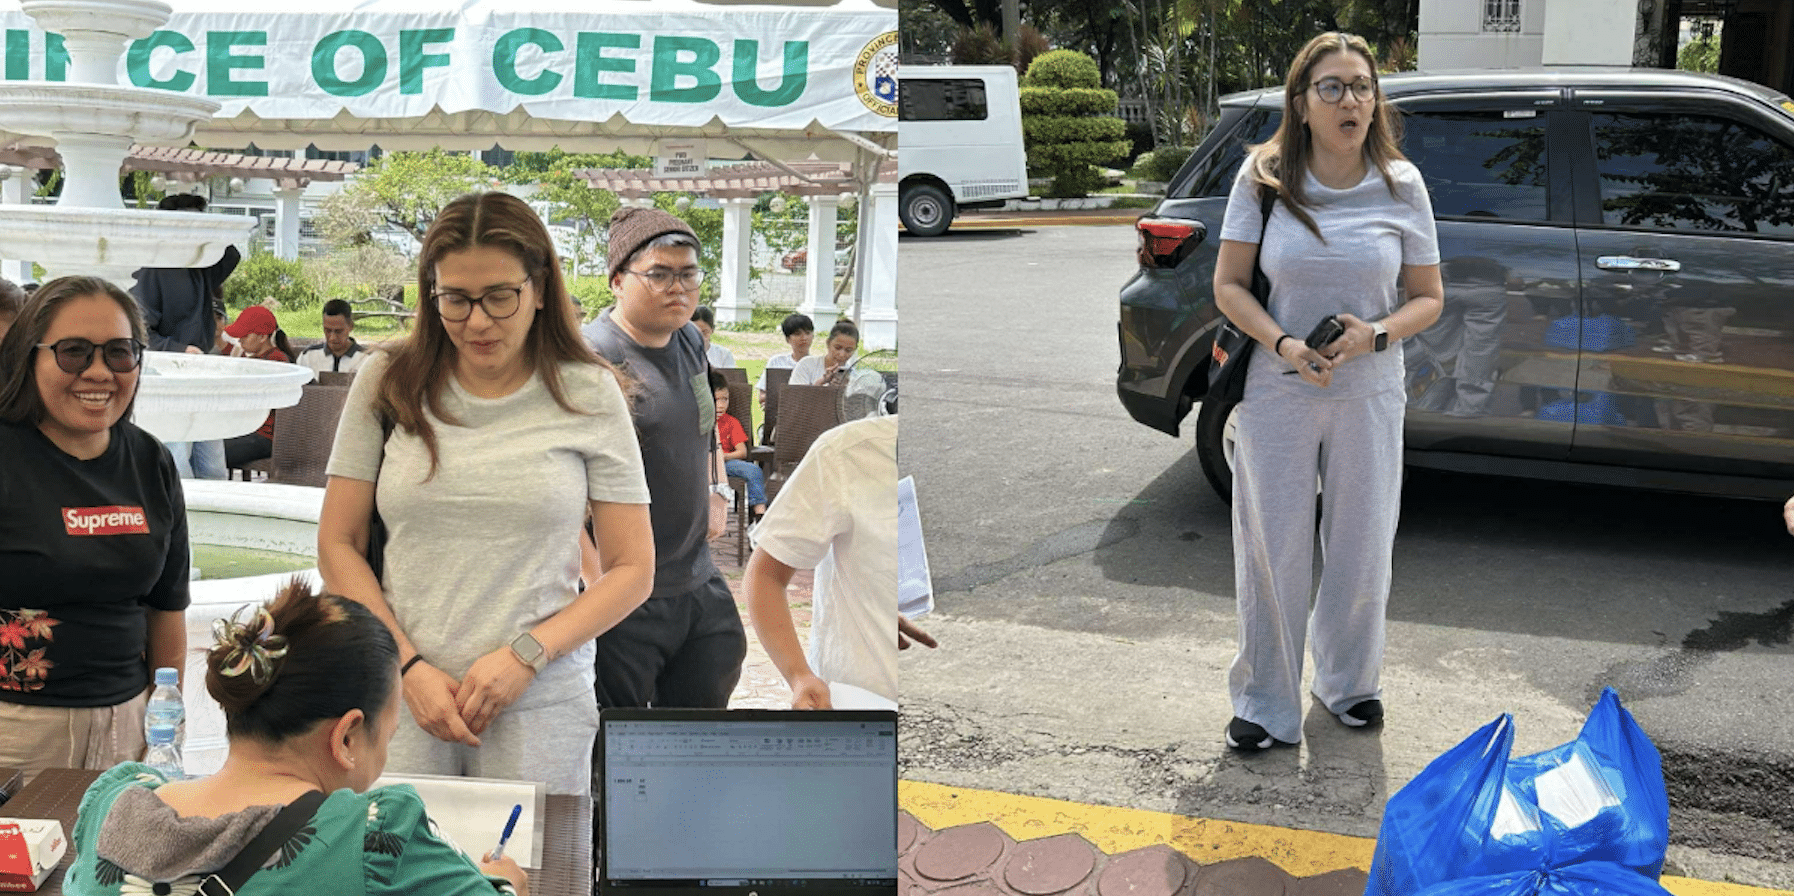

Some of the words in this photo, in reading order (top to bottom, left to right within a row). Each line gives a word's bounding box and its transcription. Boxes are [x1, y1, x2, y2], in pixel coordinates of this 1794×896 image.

[311, 28, 456, 97] OF
[492, 27, 810, 108] CEBU
[66, 508, 145, 534] Supreme
